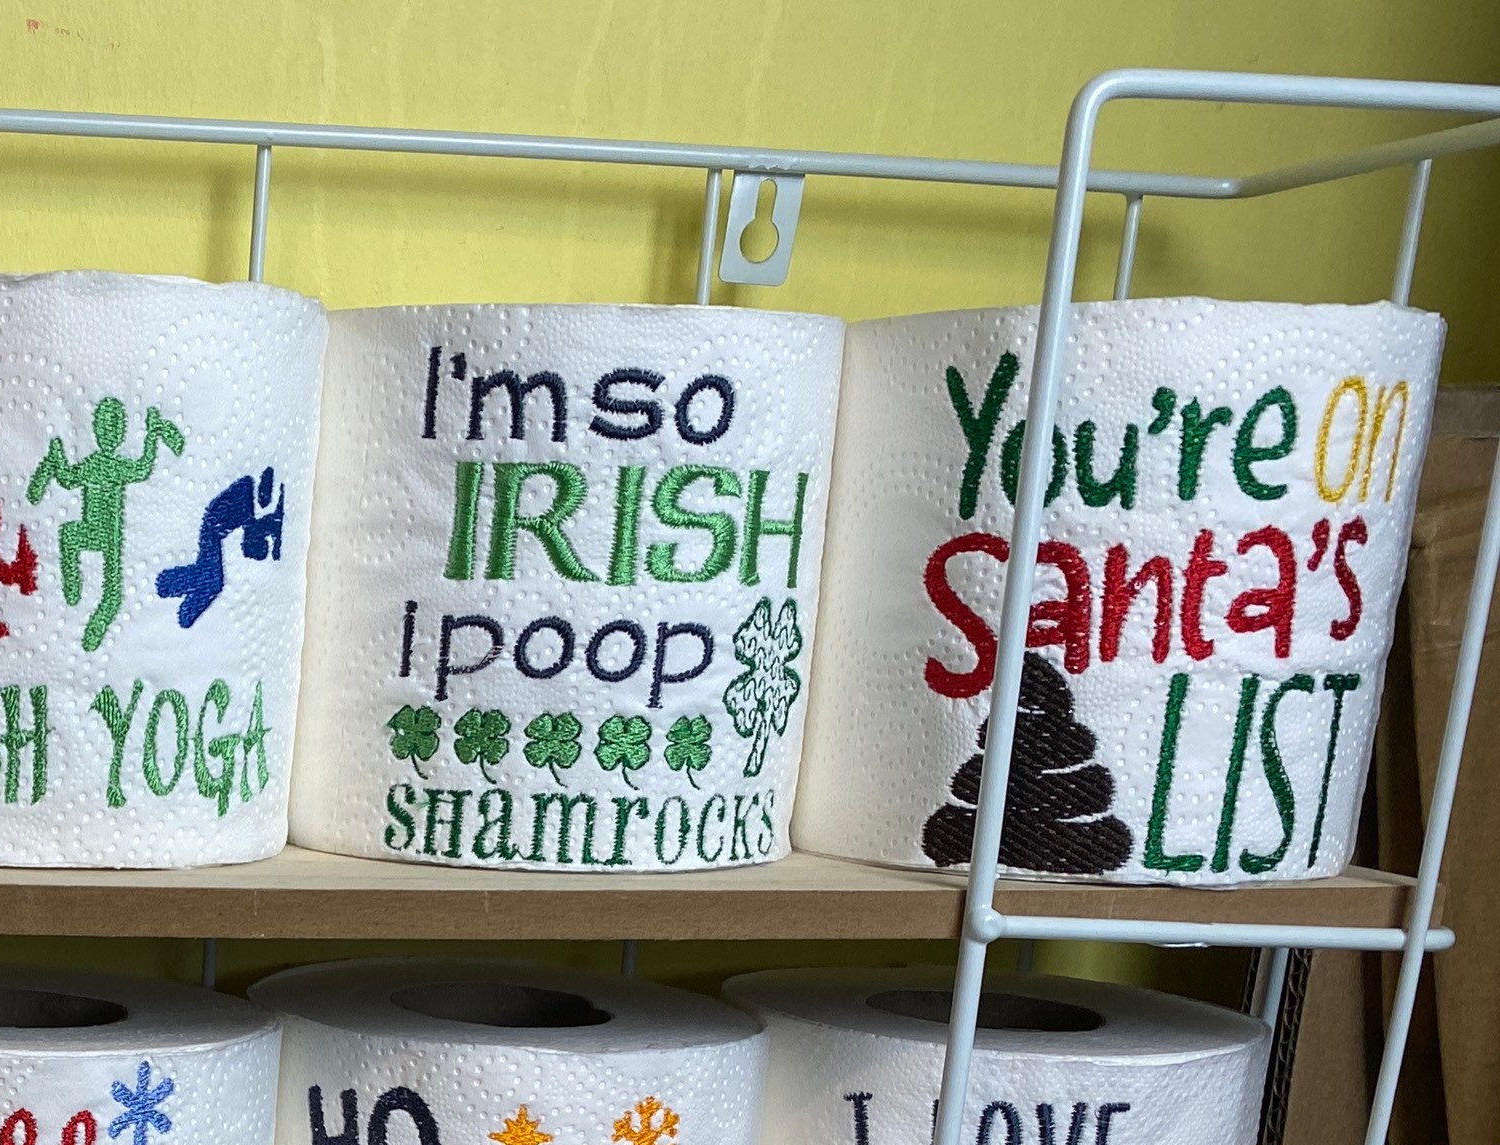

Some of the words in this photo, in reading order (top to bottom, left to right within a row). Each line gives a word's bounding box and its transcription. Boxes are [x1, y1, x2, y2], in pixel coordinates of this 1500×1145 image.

[421, 345, 569, 443] I'm
[588, 367, 737, 446] so
[944, 350, 1300, 522] You're
[443, 459, 809, 589] IRISH
[398, 599, 419, 679] I
[433, 613, 716, 709] poop
[922, 514, 1370, 699] Santa's
[89, 677, 273, 817] YOGA
[1143, 673, 1363, 876] LIST
